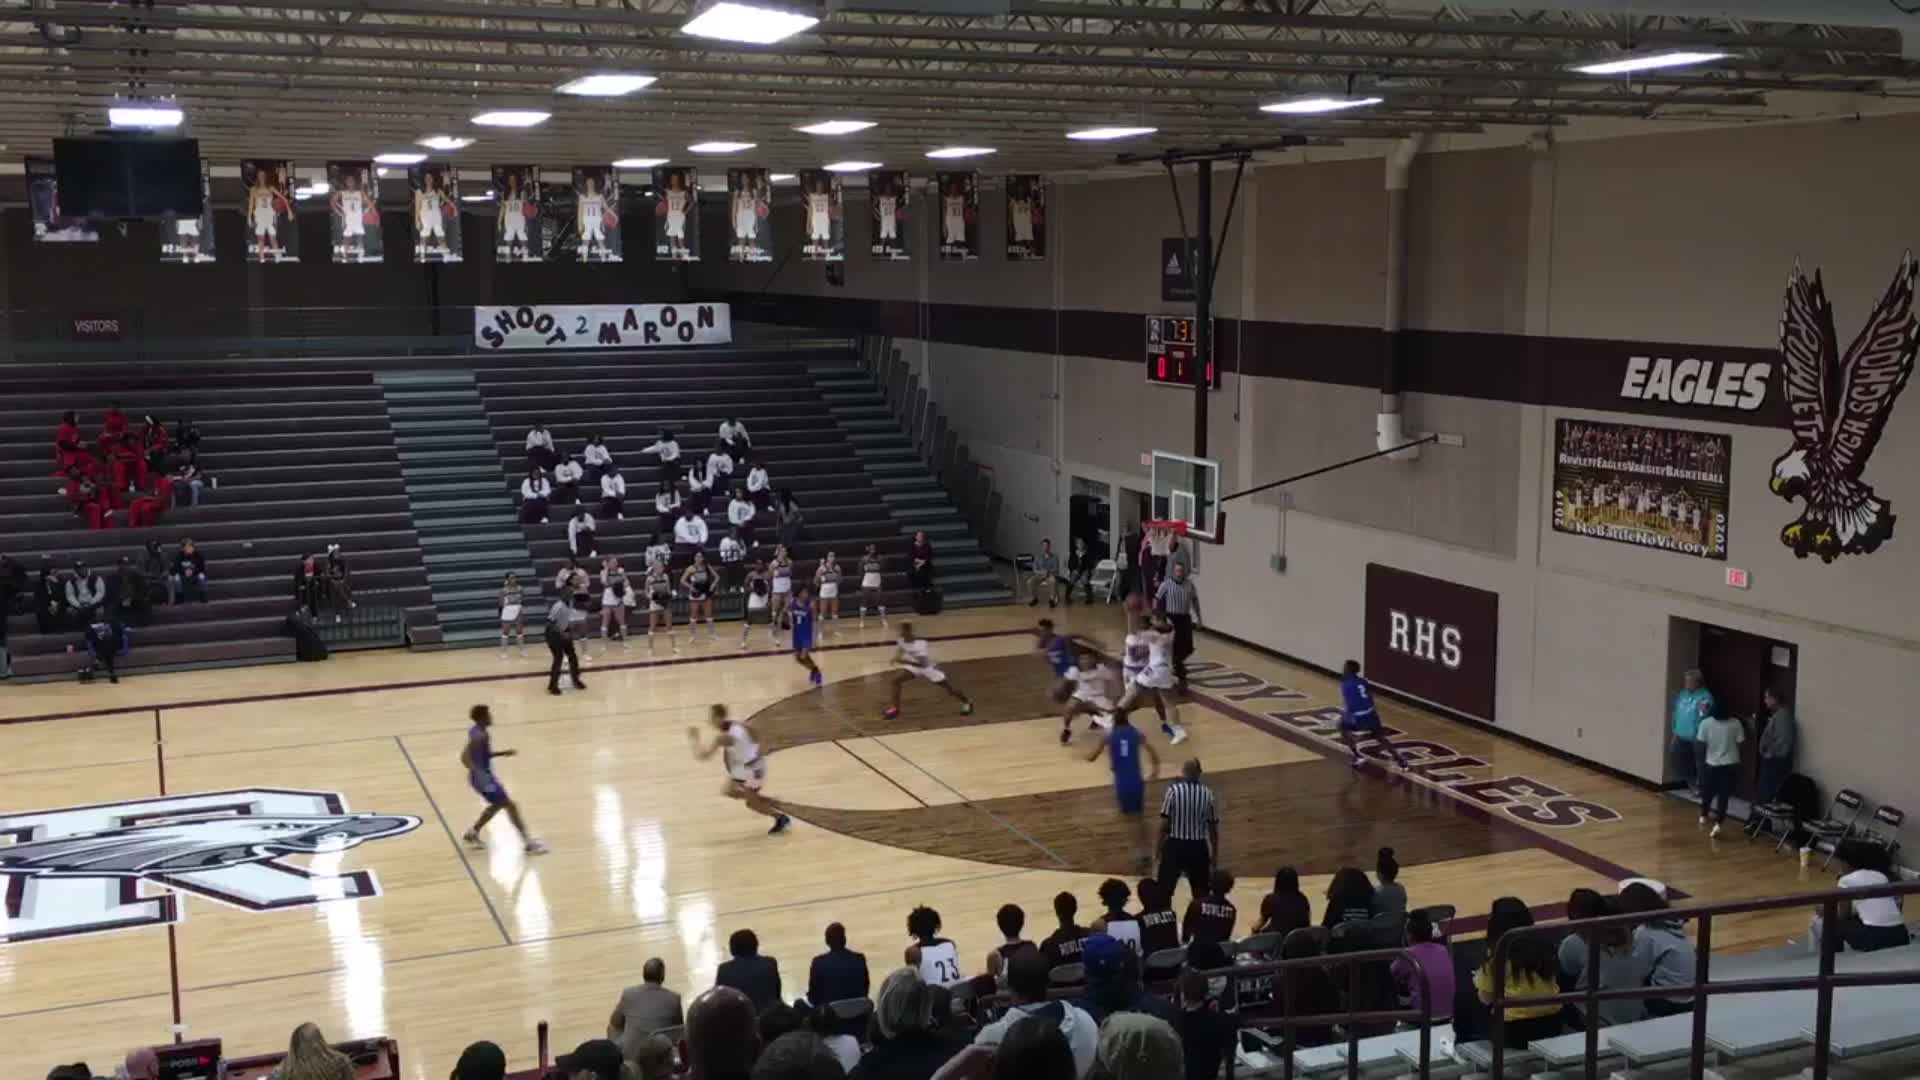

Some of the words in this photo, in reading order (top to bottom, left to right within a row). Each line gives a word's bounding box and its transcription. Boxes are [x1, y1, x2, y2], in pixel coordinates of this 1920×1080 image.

[74, 319, 119, 333] VISITORS
[481, 306, 567, 348] SHOOT
[575, 316, 588, 335] 2
[598, 306, 715, 345] MAROON
[1620, 356, 1772, 411] EAGLES
[1715, 513, 1725, 553] 2020
[1390, 610, 1461, 667] RHS
[1264, 706, 1623, 828] EGLES
[934, 957, 960, 982] 23
